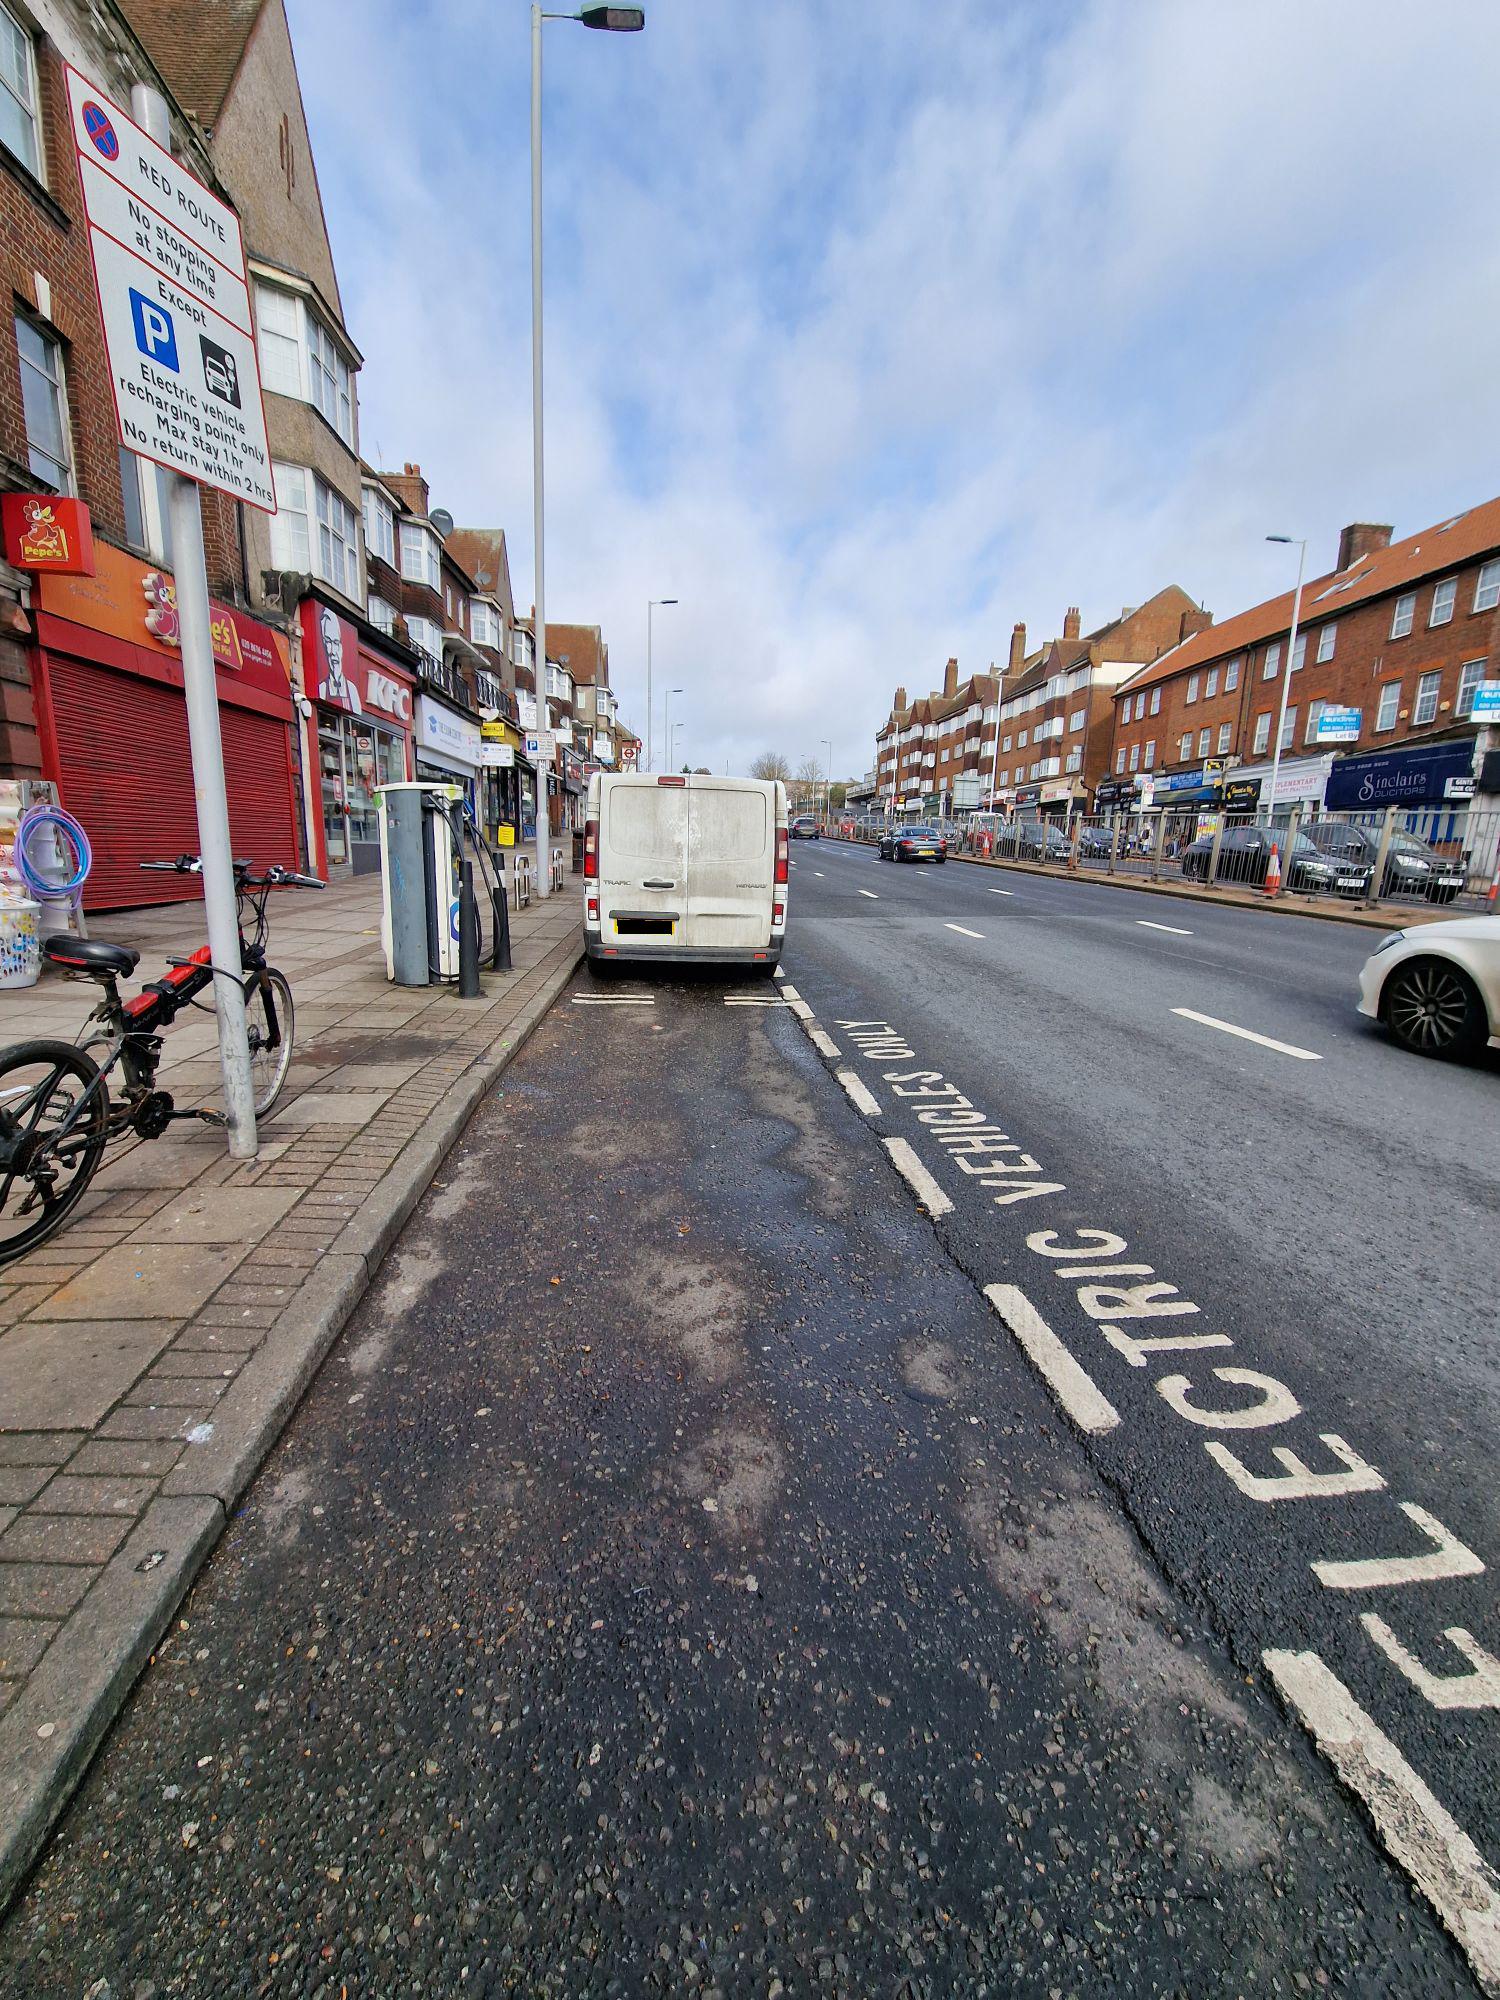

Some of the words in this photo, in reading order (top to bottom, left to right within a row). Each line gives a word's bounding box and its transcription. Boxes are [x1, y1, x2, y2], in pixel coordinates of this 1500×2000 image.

[138, 156, 172, 196] RED
[177, 189, 226, 244] ROUTE
[128, 199, 151, 230] No
[156, 225, 216, 283] stopping
[135, 231, 151, 253] at
[156, 247, 181, 276] any
[186, 266, 216, 299] time
[140, 300, 170, 355] P
[158, 280, 207, 327] Except
[120, 376, 200, 432] recharging
[205, 422, 237, 448] point
[241, 441, 265, 466] only
[140, 362, 198, 408] Electric
[202, 400, 246, 435] vehicle
[123, 418, 147, 444] No
[153, 435, 198, 468] return
[202, 460, 242, 488] within
[156, 413, 188, 442] Max
[192, 435, 220, 458] stay
[24, 546, 63, 558] Pepe's
[365, 669, 410, 721] KFC
[1358, 770, 1427, 801] Sinclairs
[604, 879, 631, 887] TRAFIC
[832, 1019, 916, 1060] ONLY
[881, 1070, 1067, 1205] VEHICLES
